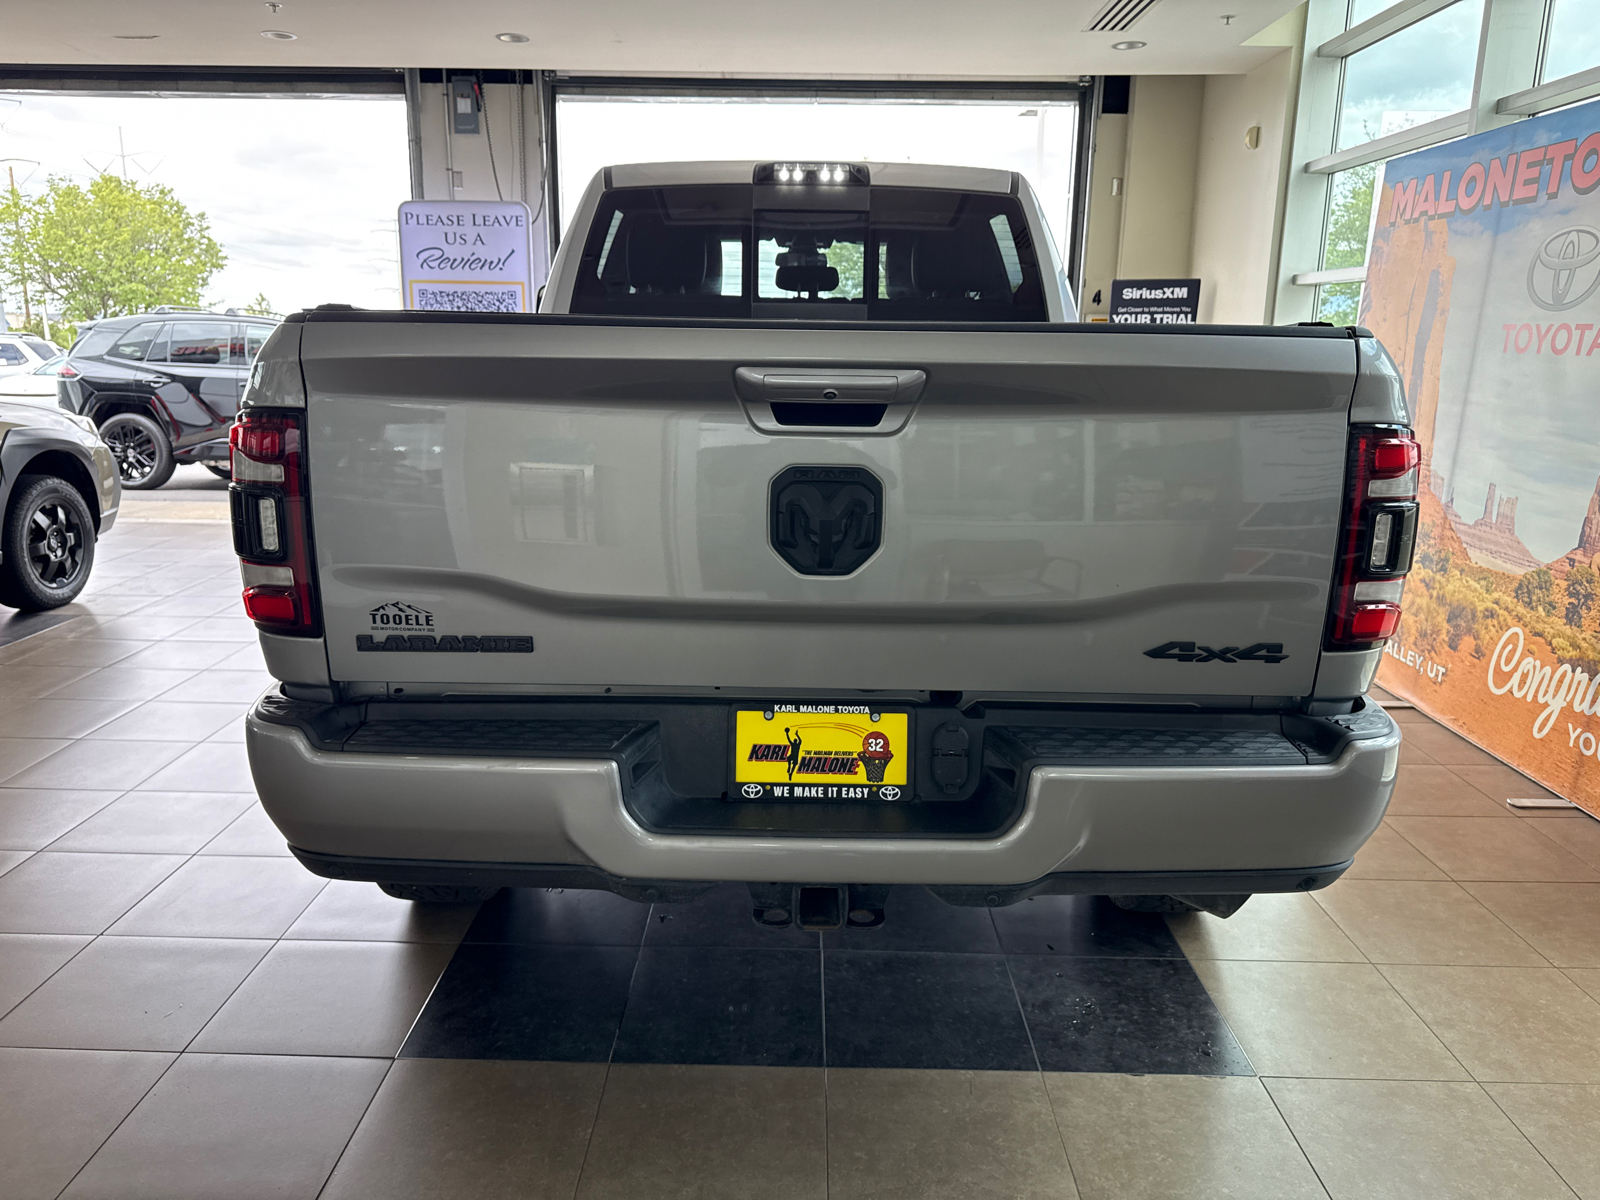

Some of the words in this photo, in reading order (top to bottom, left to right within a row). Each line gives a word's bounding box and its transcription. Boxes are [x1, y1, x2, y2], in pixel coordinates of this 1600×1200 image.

[404, 212, 465, 227] PLEASE
[472, 213, 524, 227] LEAVE
[444, 232, 467, 246] US
[473, 233, 486, 246] A
[415, 246, 516, 271] Review!
[1092, 289, 1102, 306] 4
[1122, 287, 1188, 300] SiriusXM
[1112, 313, 1151, 324] YOUR
[1153, 313, 1196, 325] TRIAL
[793, 469, 860, 479] RAM
[369, 612, 434, 626] TOOELE
[356, 634, 534, 653] LARAMIE
[1143, 641, 1290, 664] 4x4
[1384, 639, 1424, 675] ALLEY,
[1427, 660, 1446, 683] UT
[774, 704, 798, 713] KARL
[799, 705, 836, 714] MALONE
[837, 705, 870, 714] TOYOTA
[868, 738, 884, 752] 32
[1568, 722, 1600, 762] YO
[747, 743, 791, 762] KARL
[796, 756, 859, 775] MALONE
[773, 786, 790, 797] WE
[793, 786, 824, 798] MAKE
[828, 787, 838, 798] IT
[841, 787, 869, 799] EASY
